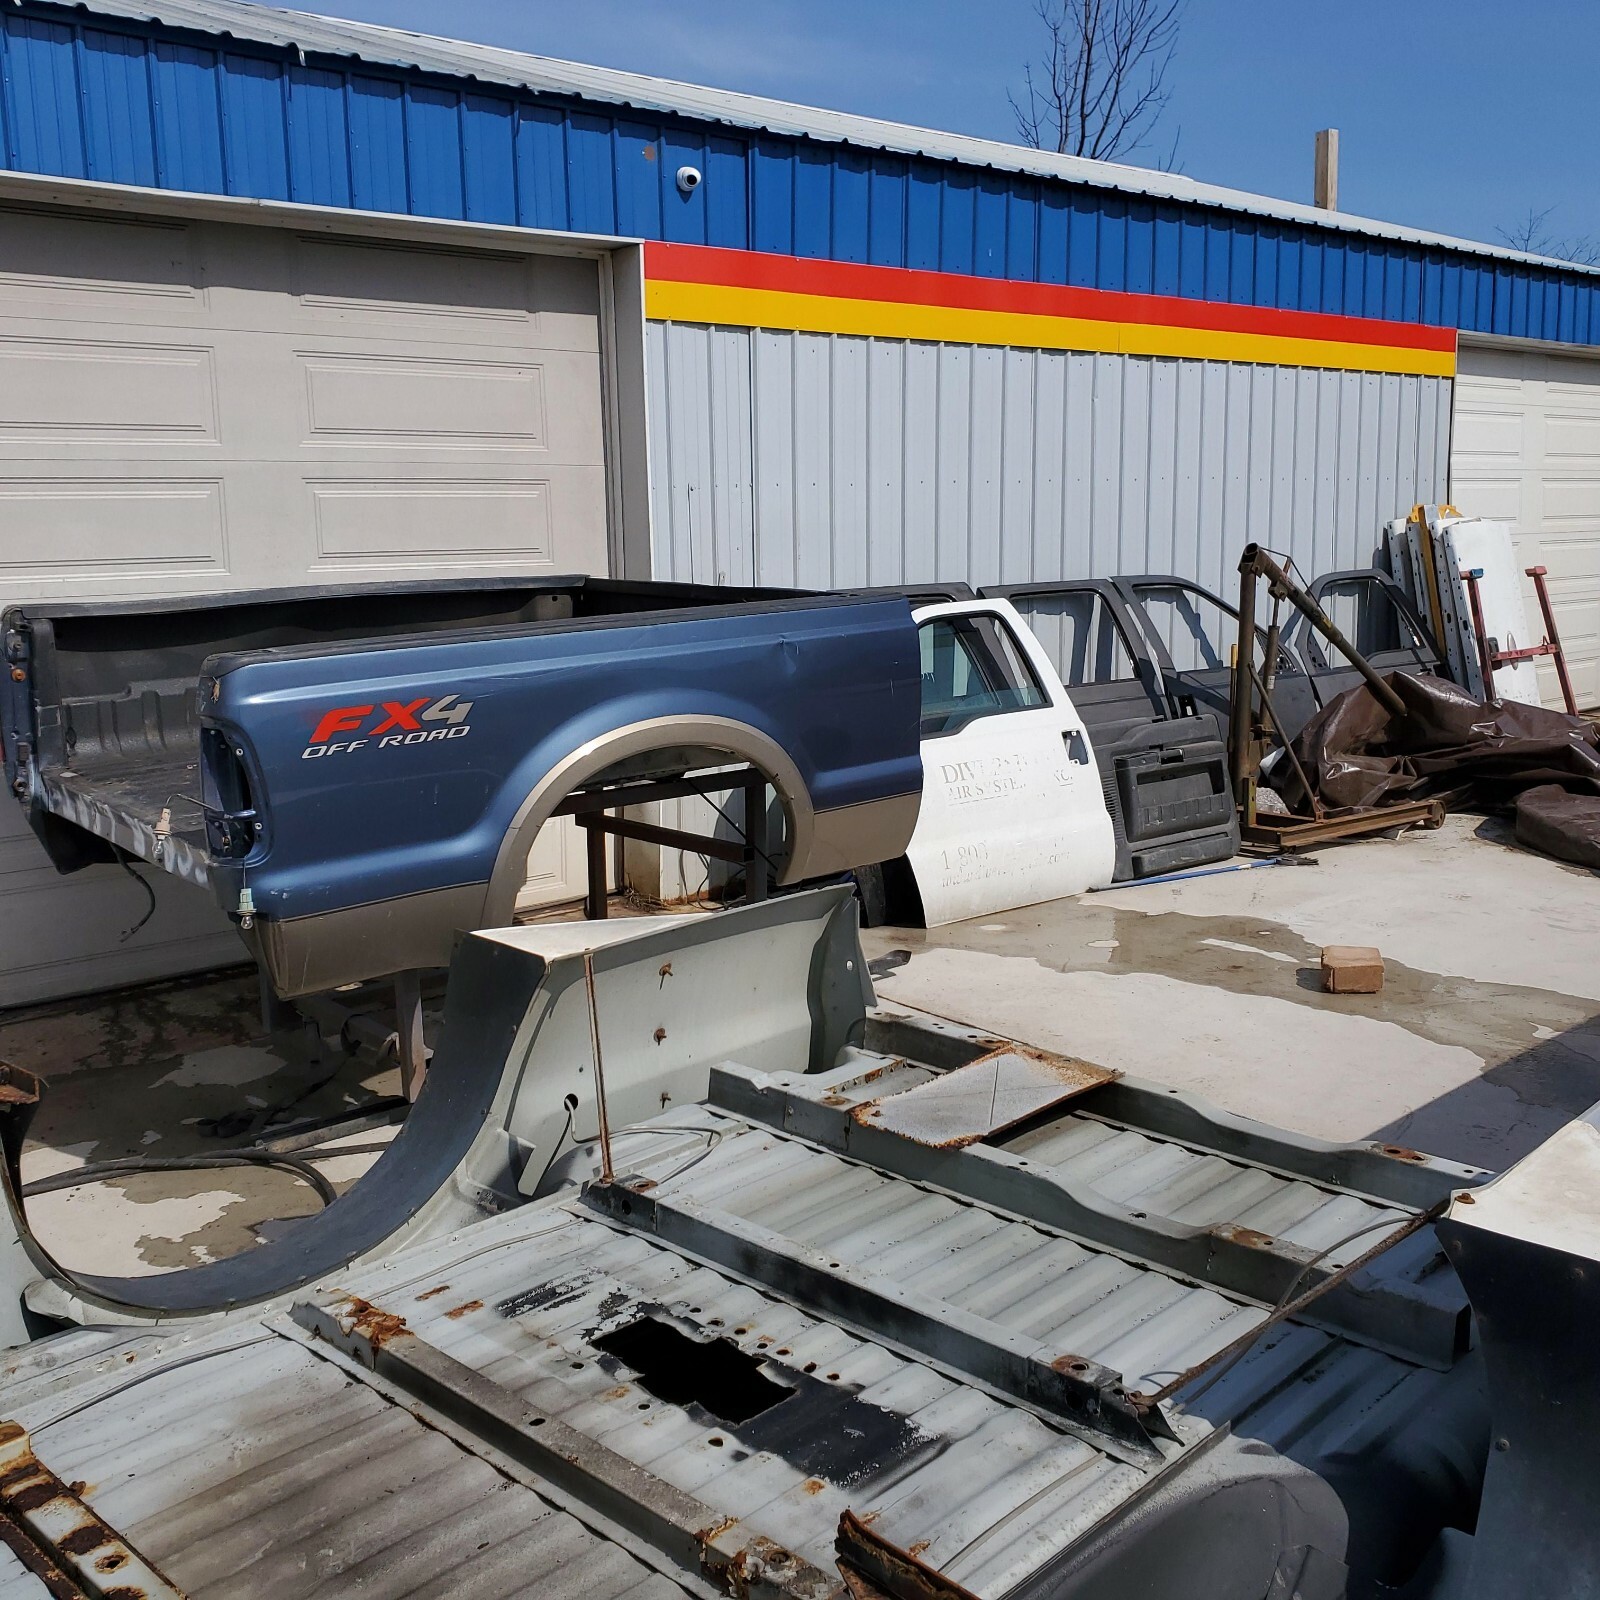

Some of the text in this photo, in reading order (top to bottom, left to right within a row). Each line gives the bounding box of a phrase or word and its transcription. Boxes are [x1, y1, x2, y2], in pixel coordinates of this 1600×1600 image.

[308, 694, 474, 743] FX4
[301, 725, 471, 759] OFF ROAD
